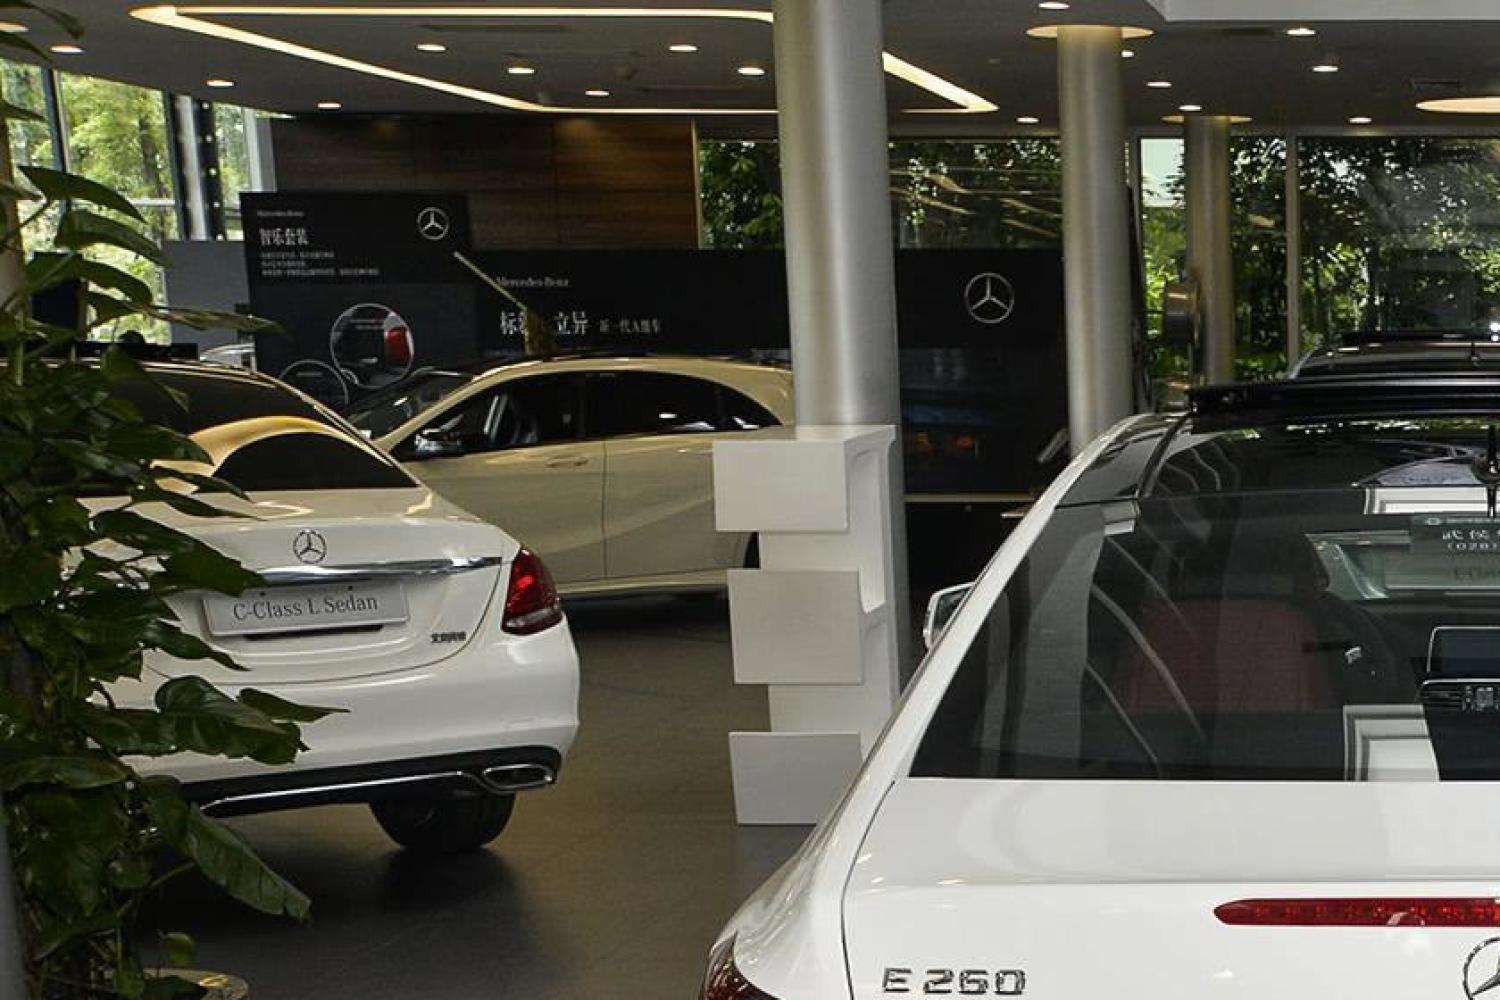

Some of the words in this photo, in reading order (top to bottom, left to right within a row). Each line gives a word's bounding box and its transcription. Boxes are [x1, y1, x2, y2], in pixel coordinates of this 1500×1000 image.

[233, 601, 303, 621] C-Class
[307, 598, 320, 615] L
[324, 596, 379, 614] Sedan
[881, 967, 912, 993] E
[922, 969, 1026, 995] 260
